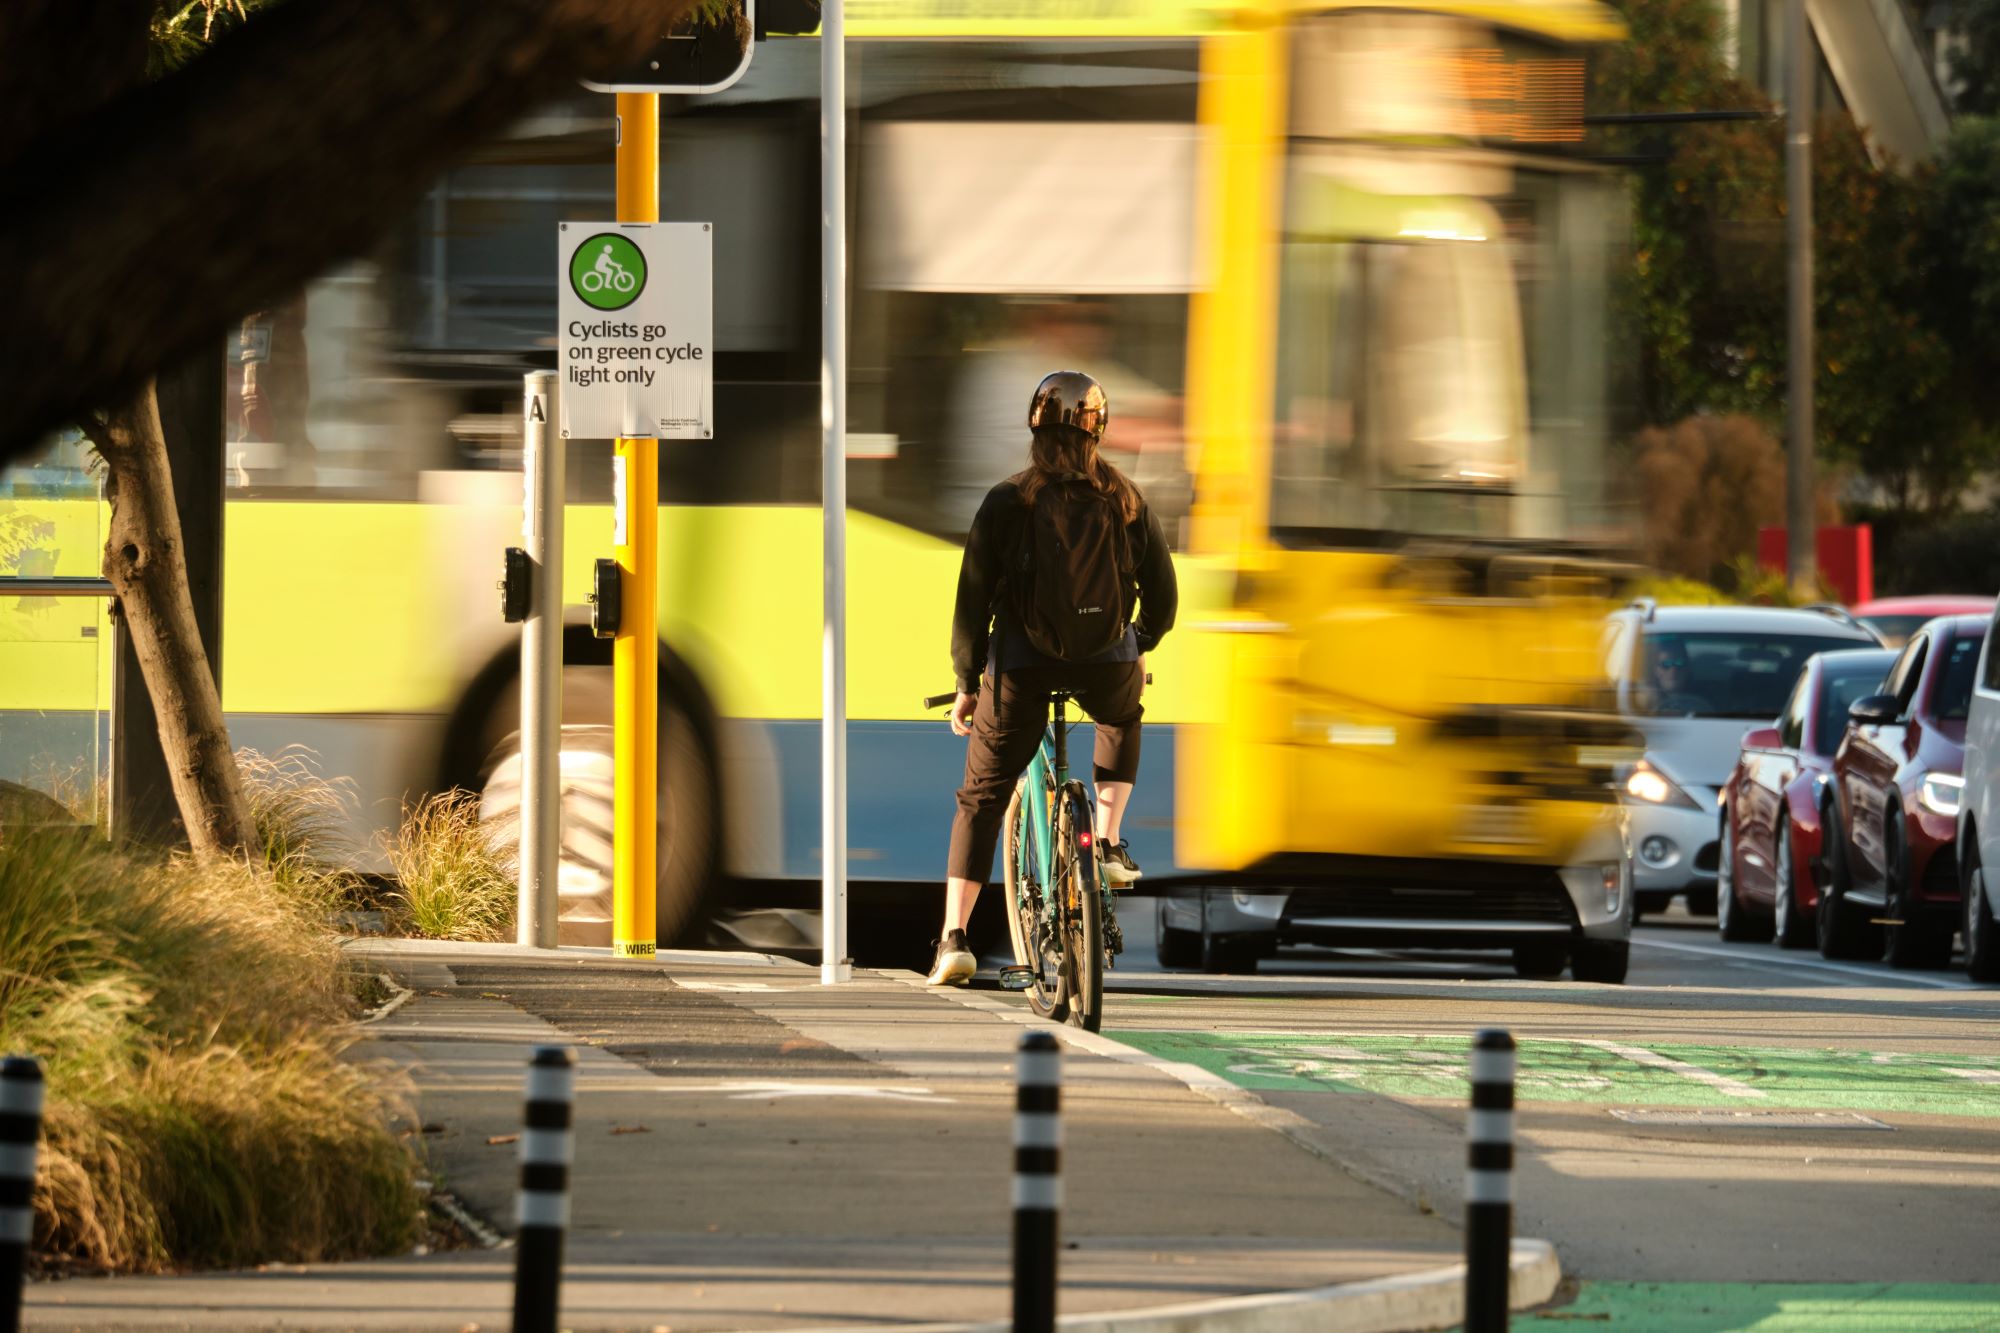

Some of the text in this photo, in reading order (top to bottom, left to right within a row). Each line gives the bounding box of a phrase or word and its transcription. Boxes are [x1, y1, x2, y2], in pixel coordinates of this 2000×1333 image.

[569, 321, 667, 342] Cyclists go
[569, 343, 703, 364] on green cycle
[569, 366, 655, 387] light only
[529, 395, 545, 422] A
